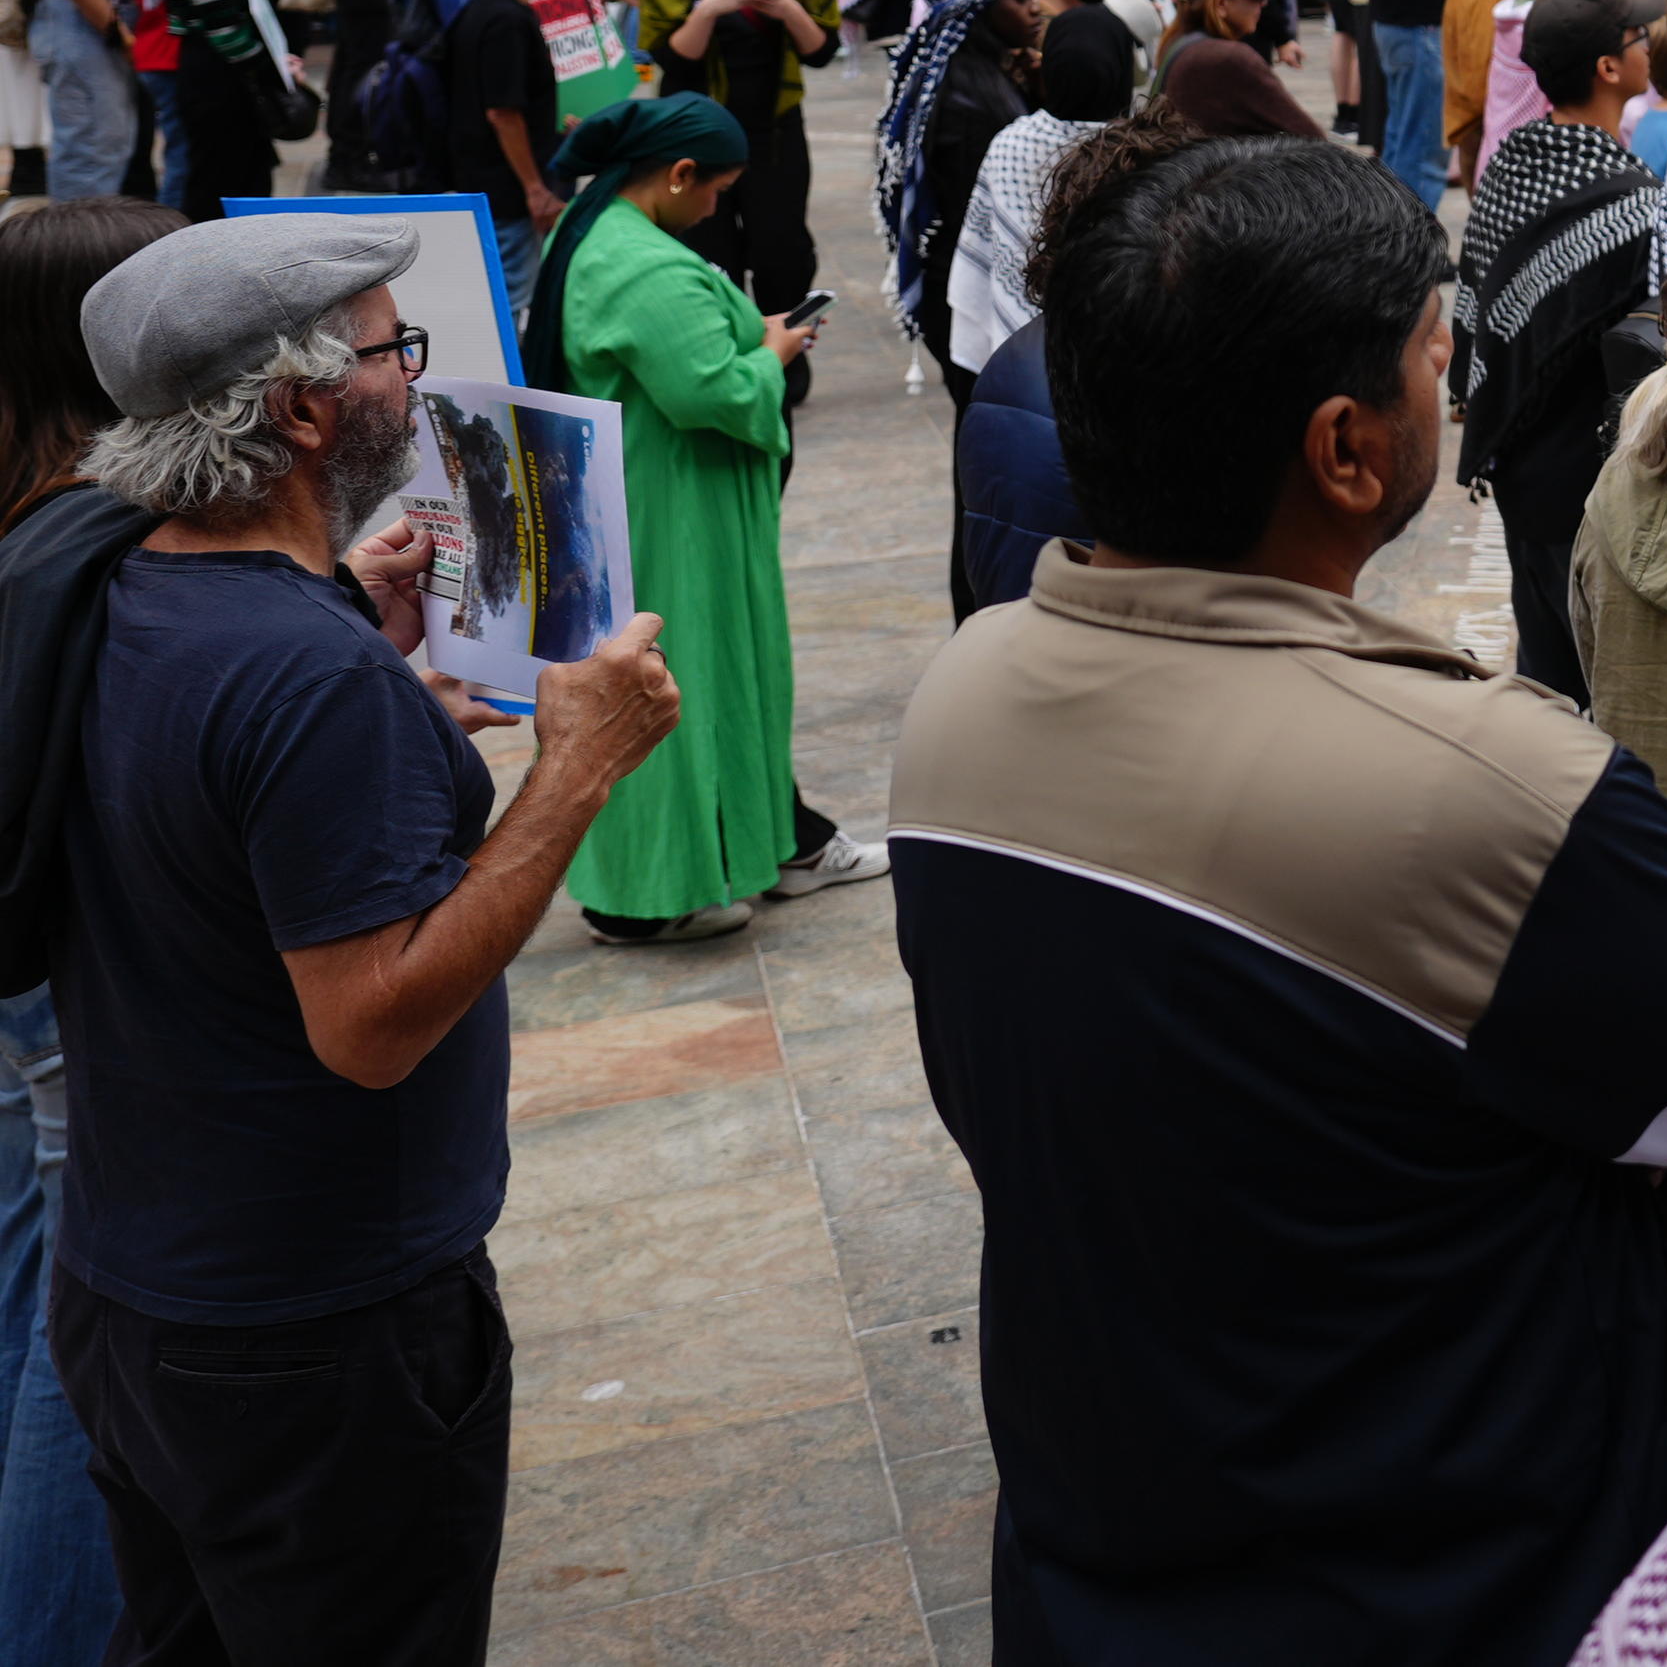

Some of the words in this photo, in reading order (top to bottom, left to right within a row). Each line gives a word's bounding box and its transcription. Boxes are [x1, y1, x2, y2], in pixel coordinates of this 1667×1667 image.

[526, 451, 546, 531] Different
[414, 499, 427, 509] IN
[429, 501, 448, 511] OUR
[405, 510, 462, 525] THOUSANDS
[432, 533, 464, 552] LIONS
